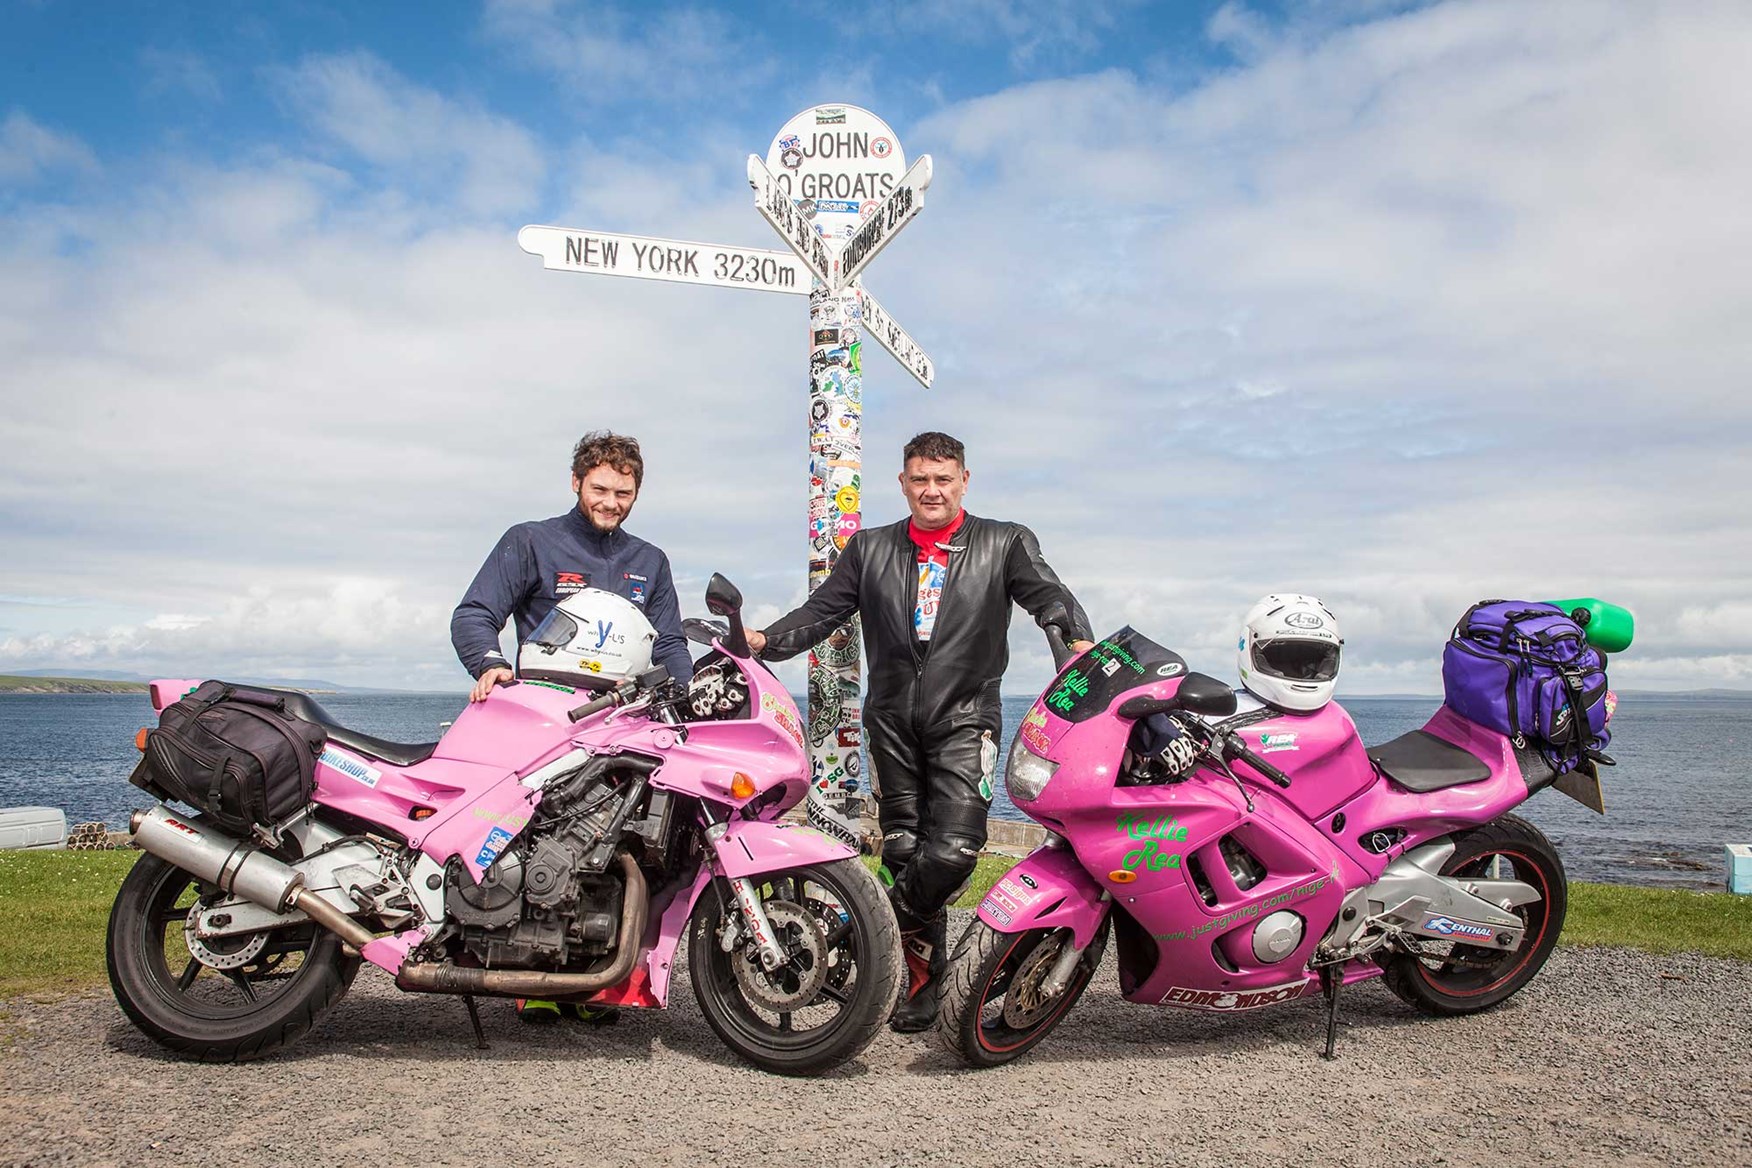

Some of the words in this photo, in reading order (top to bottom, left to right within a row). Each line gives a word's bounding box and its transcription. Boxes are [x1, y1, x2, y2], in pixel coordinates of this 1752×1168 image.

[803, 132, 868, 158] JOHN
[566, 236, 619, 268] NEW
[632, 242, 699, 277] YORK
[714, 252, 795, 287] 3230m
[1063, 668, 1089, 697] Kellie
[1048, 688, 1075, 712] Rea
[1116, 813, 1188, 842] Kellie
[1122, 840, 1181, 871] Rea
